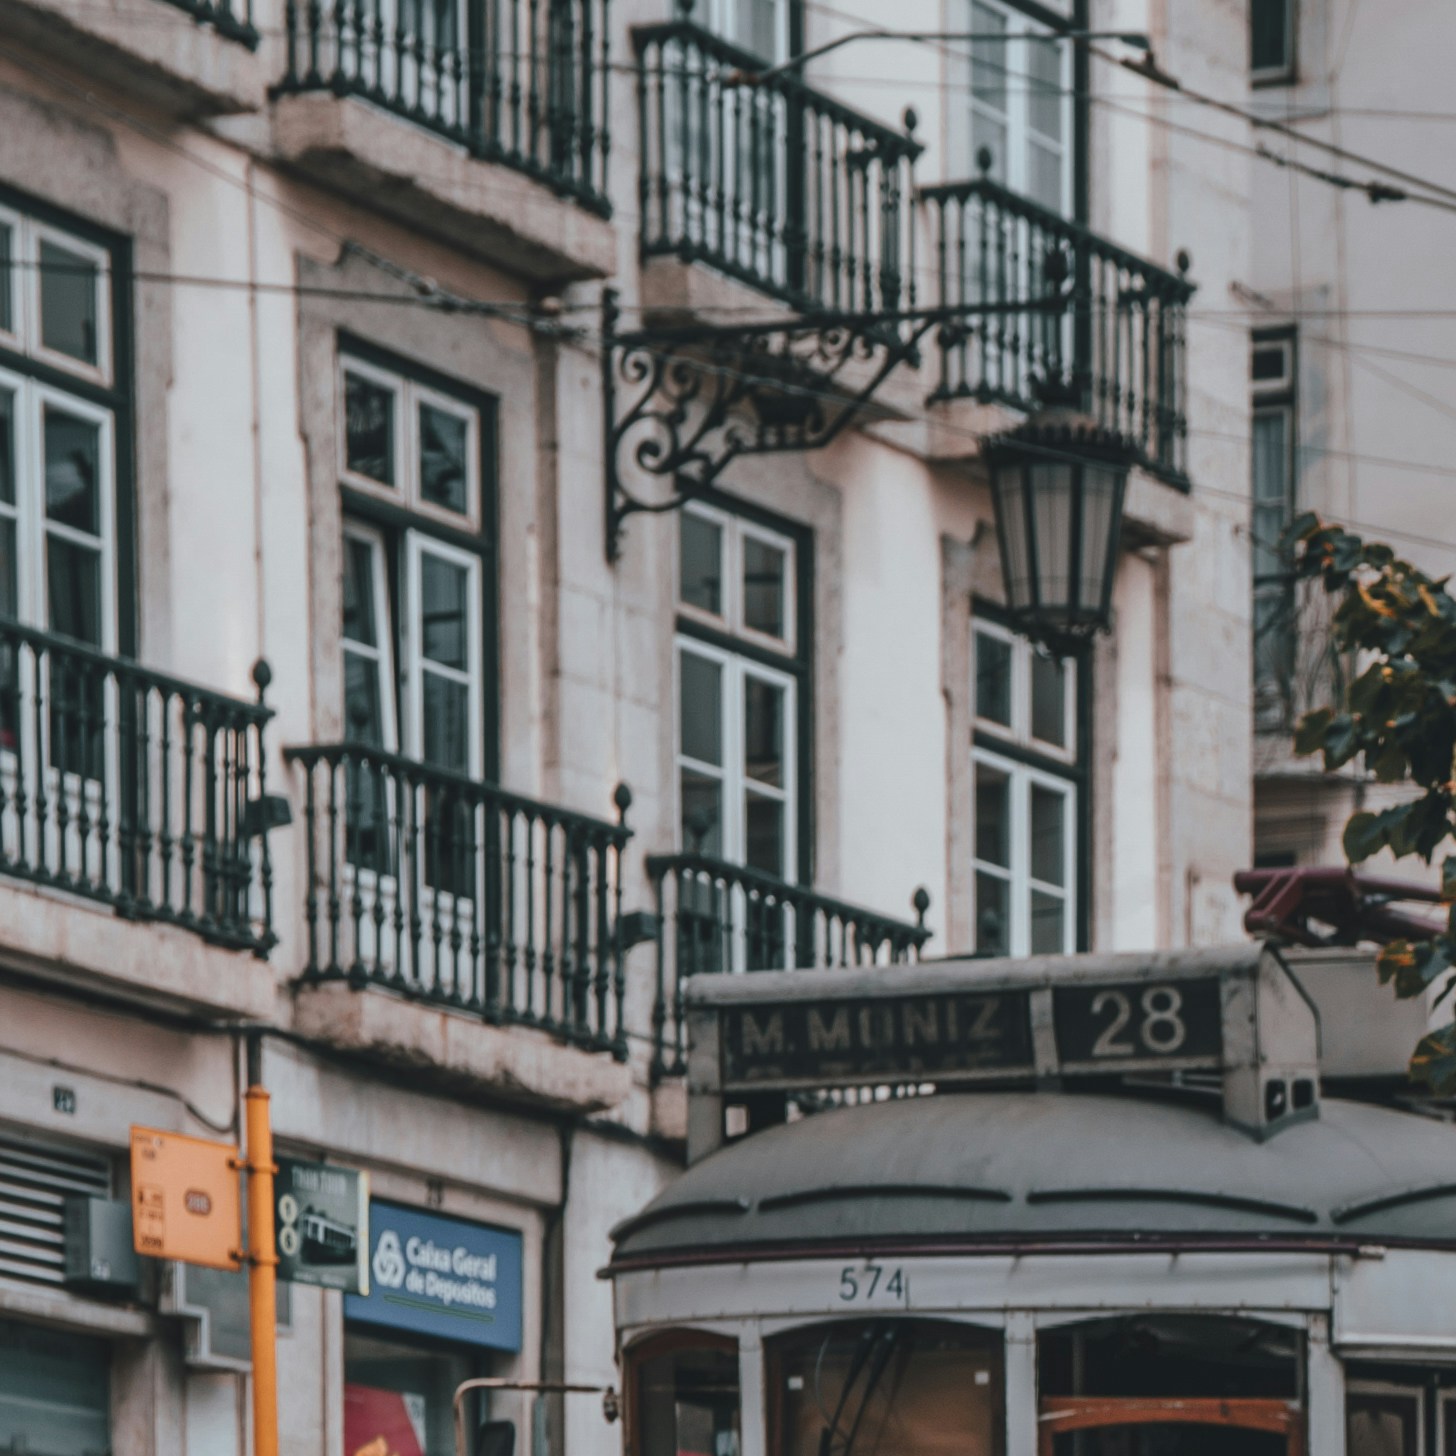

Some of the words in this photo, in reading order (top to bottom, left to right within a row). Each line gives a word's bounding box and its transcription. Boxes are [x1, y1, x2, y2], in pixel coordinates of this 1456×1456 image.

[740, 1009, 796, 1055] M.
[807, 999, 1000, 1050] MONIZ
[1091, 985, 1187, 1057] 28
[405, 1235, 451, 1273] Caixa
[452, 1246, 497, 1282] Geral
[405, 1266, 424, 1294] de
[839, 1265, 903, 1301] 574
